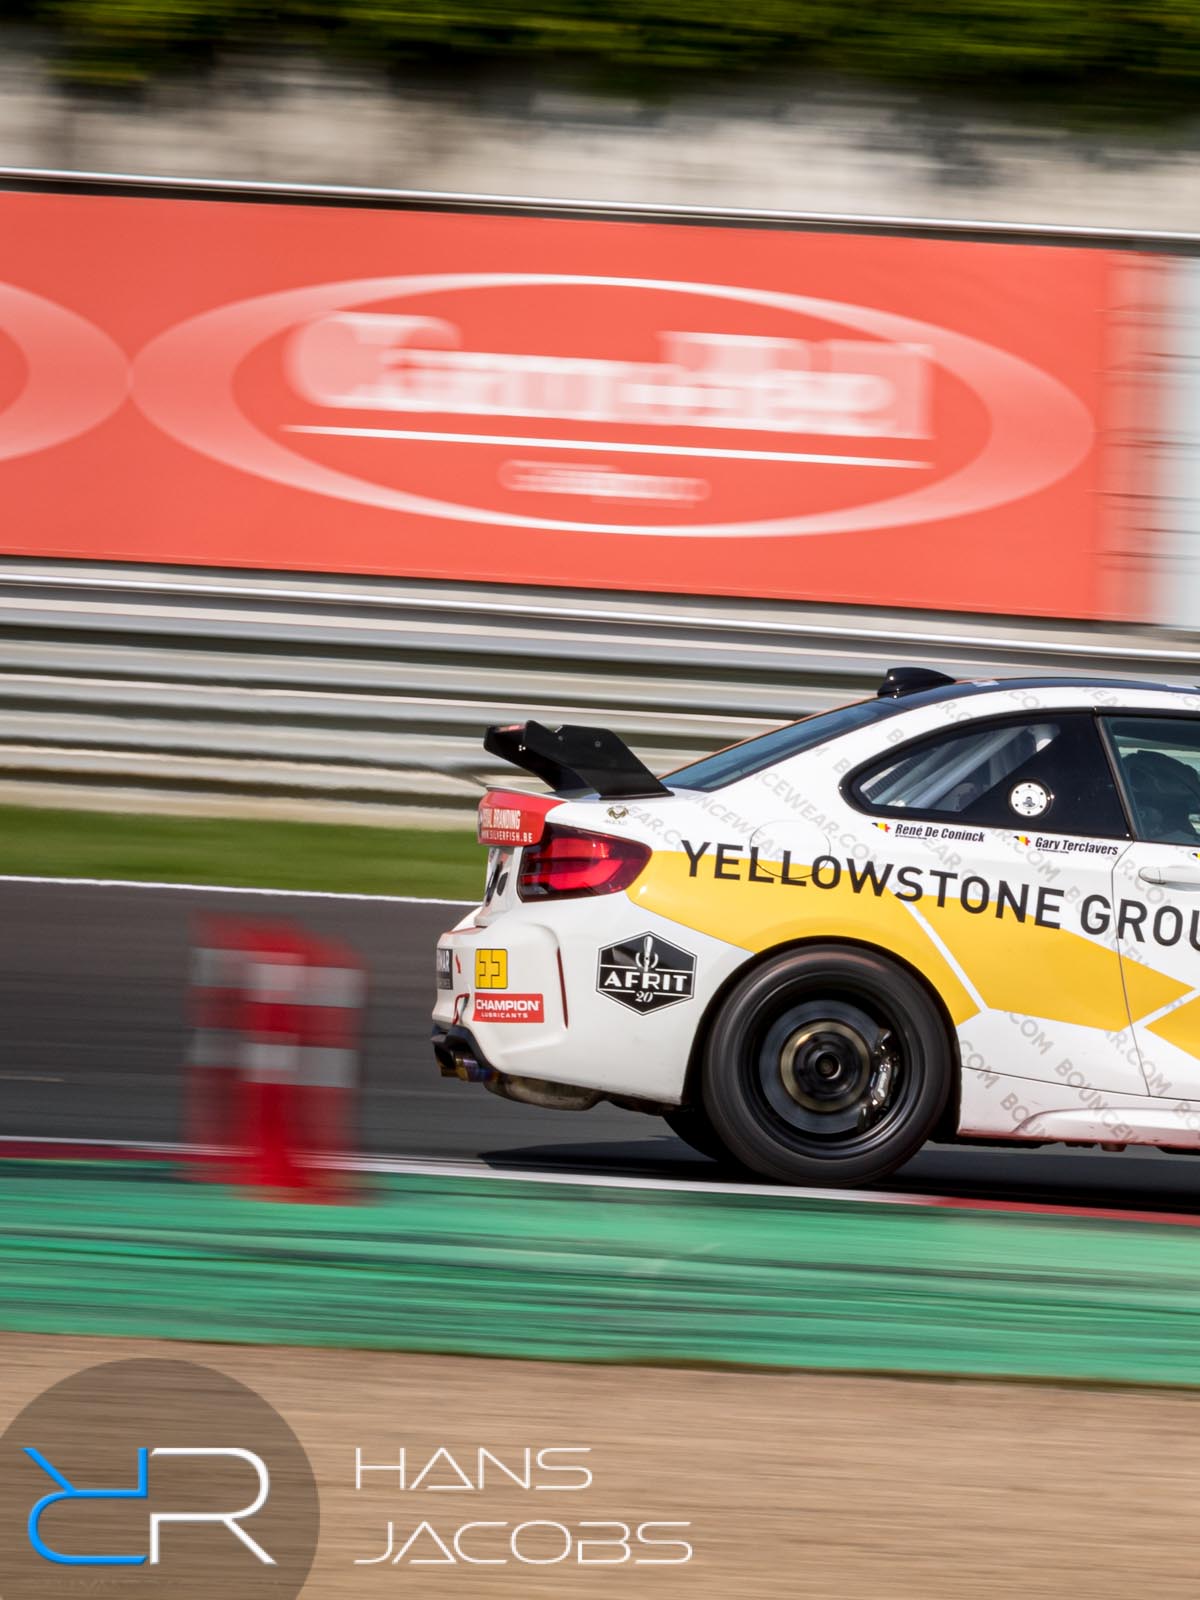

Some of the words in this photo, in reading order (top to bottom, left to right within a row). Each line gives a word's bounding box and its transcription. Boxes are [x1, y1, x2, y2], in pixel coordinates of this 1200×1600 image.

[895, 823, 923, 836] René
[925, 826, 939, 837] De
[941, 828, 985, 842] Coninck
[1035, 837, 1060, 850] Gary
[1062, 840, 1119, 855] Terclavers
[681, 839, 1065, 929] YELLOWSTONE
[604, 970, 688, 992] AFRIT
[476, 999, 540, 1011] CHAMPION
[634, 990, 654, 1003] 20
